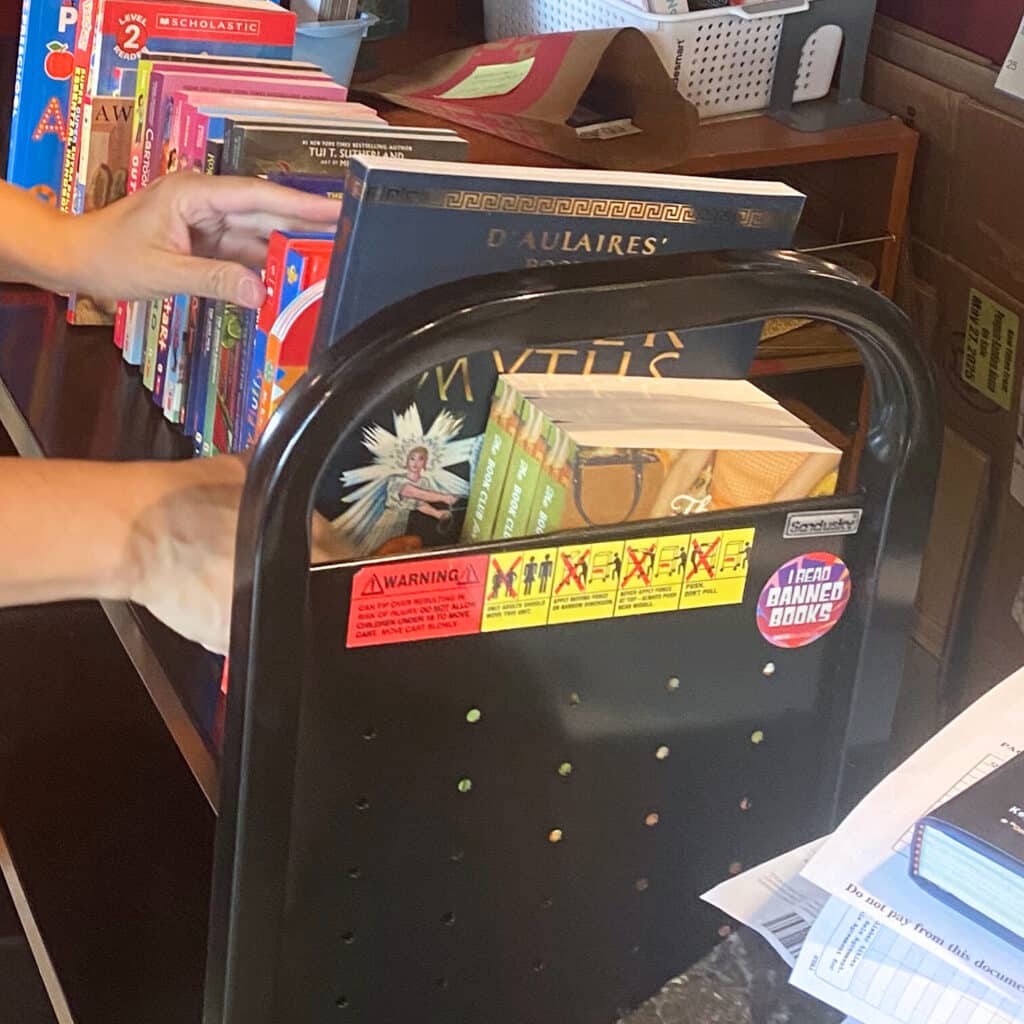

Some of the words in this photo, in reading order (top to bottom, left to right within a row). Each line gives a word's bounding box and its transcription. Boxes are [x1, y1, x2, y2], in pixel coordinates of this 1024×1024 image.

[118, 13, 147, 27] LEVEL
[171, 17, 257, 33] SCHOLASTIC
[124, 24, 140, 49] 2
[1006, 59, 1018, 71] 25
[309, 147, 326, 157] TUI
[329, 148, 337, 158] T.
[487, 228, 669, 255] D'AULAIRES'
[970, 296, 982, 324] May
[965, 345, 977, 380] 2025
[483, 458, 495, 490] BOOK
[476, 490, 488, 521] CLUB
[508, 484, 522, 517] BOOK
[791, 519, 855, 530] Sandusky
[383, 569, 459, 589] WARNING
[788, 570, 795, 584] I
[796, 566, 832, 584] READ
[766, 581, 844, 607] BANNED
[449, 611, 471, 620] MOVE
[768, 602, 833, 627] BOOKS
[845, 882, 864, 898] Do
[864, 896, 888, 914] not
[886, 910, 912, 927] pay
[914, 922, 945, 947] from
[947, 942, 971, 962] this
